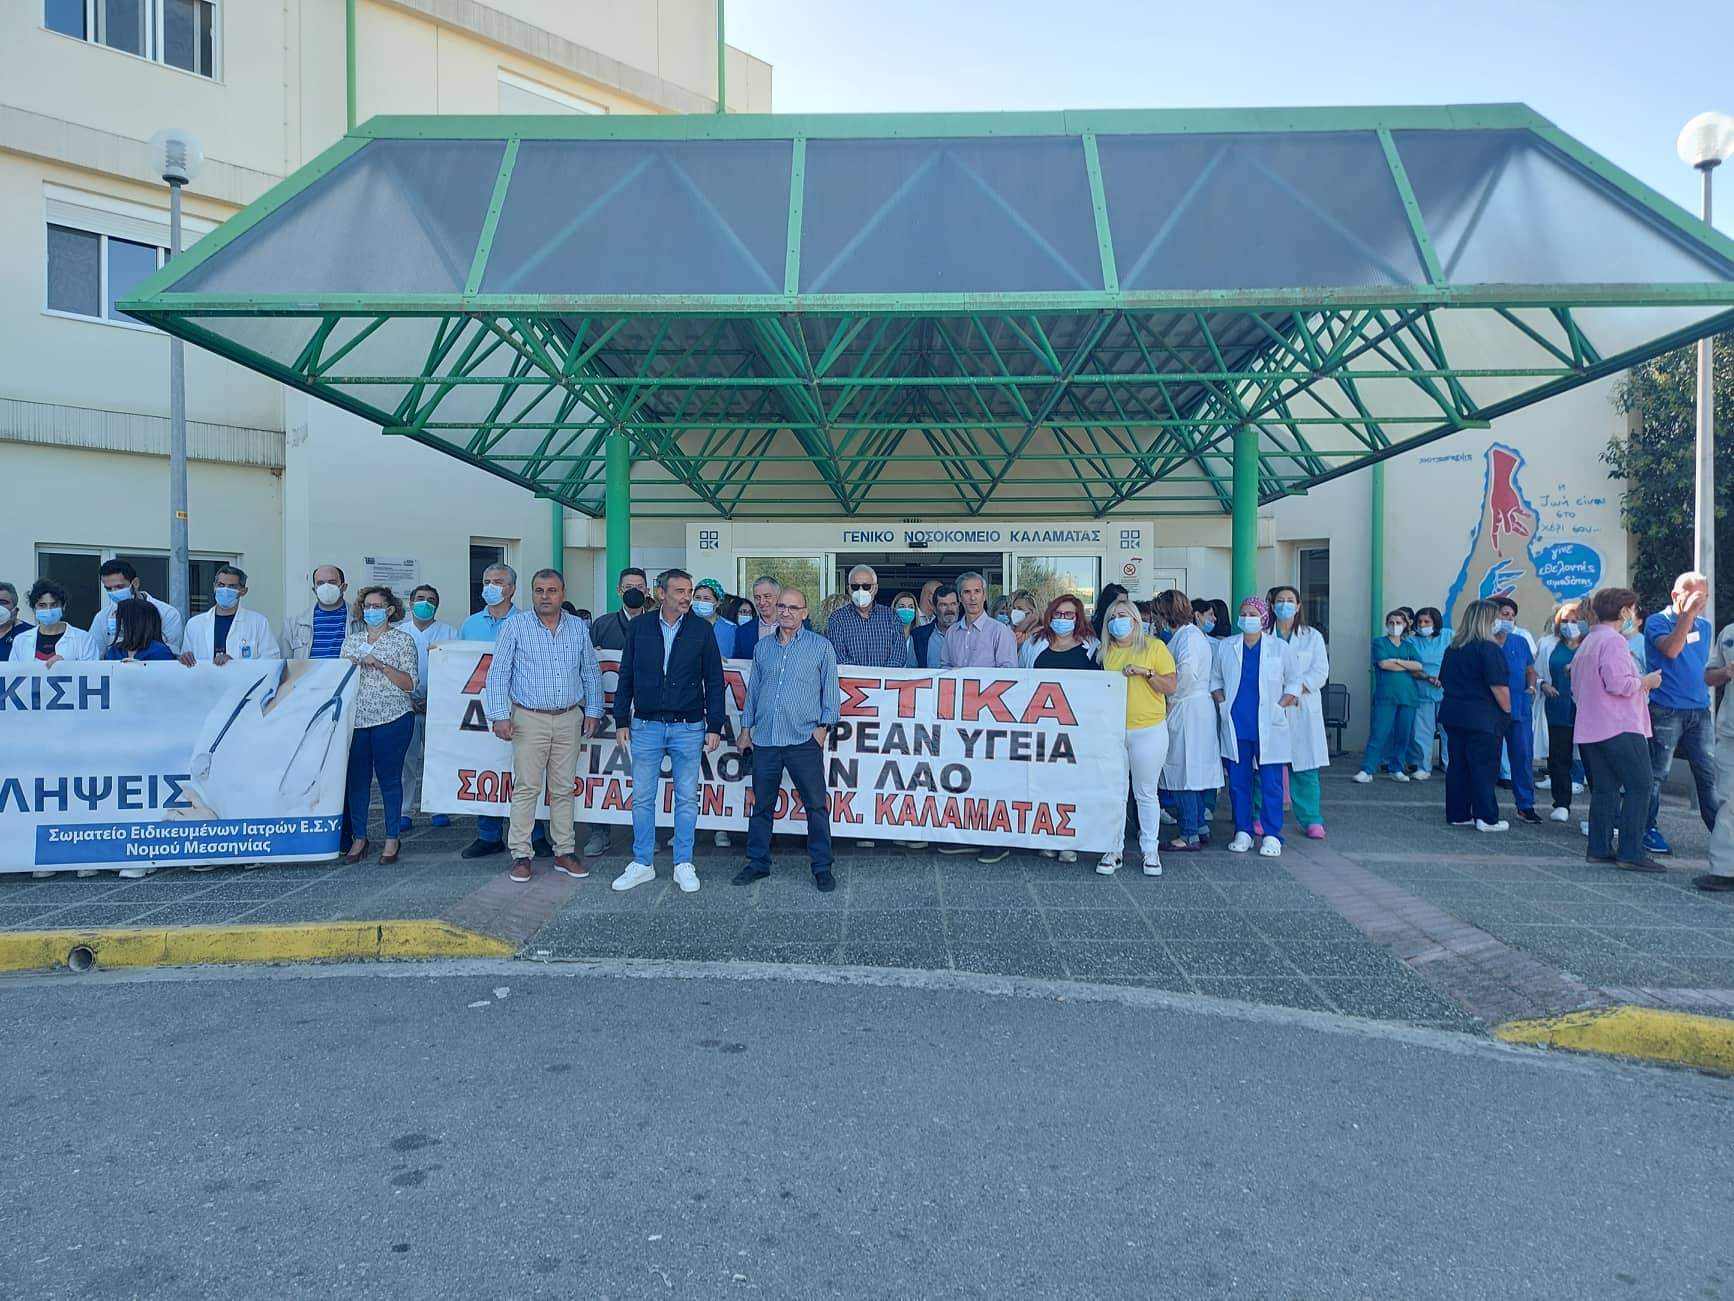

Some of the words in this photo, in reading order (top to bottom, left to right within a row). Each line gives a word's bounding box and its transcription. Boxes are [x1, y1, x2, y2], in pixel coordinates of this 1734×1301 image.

[843, 531, 894, 543] ΓΕΝΙΚΟ
[904, 530, 1000, 543] ΝΟΣΟΚΟΜΕΙΟ
[1010, 530, 1101, 542] ΚΑΛΑΜΑΤΑΣ
[957, 727, 1077, 764] ΥΓΕΙΑ
[874, 760, 972, 794] ΛΑΟ
[874, 792, 1077, 837] ΚΑΛΑΜΑΤΑΣ
[49, 826, 126, 844] Σωματείο
[131, 823, 238, 840] Ειδικευμένων
[243, 820, 297, 837] Ιατρών
[126, 841, 180, 857] Νομού
[184, 838, 271, 855] Μεσσηνίας
